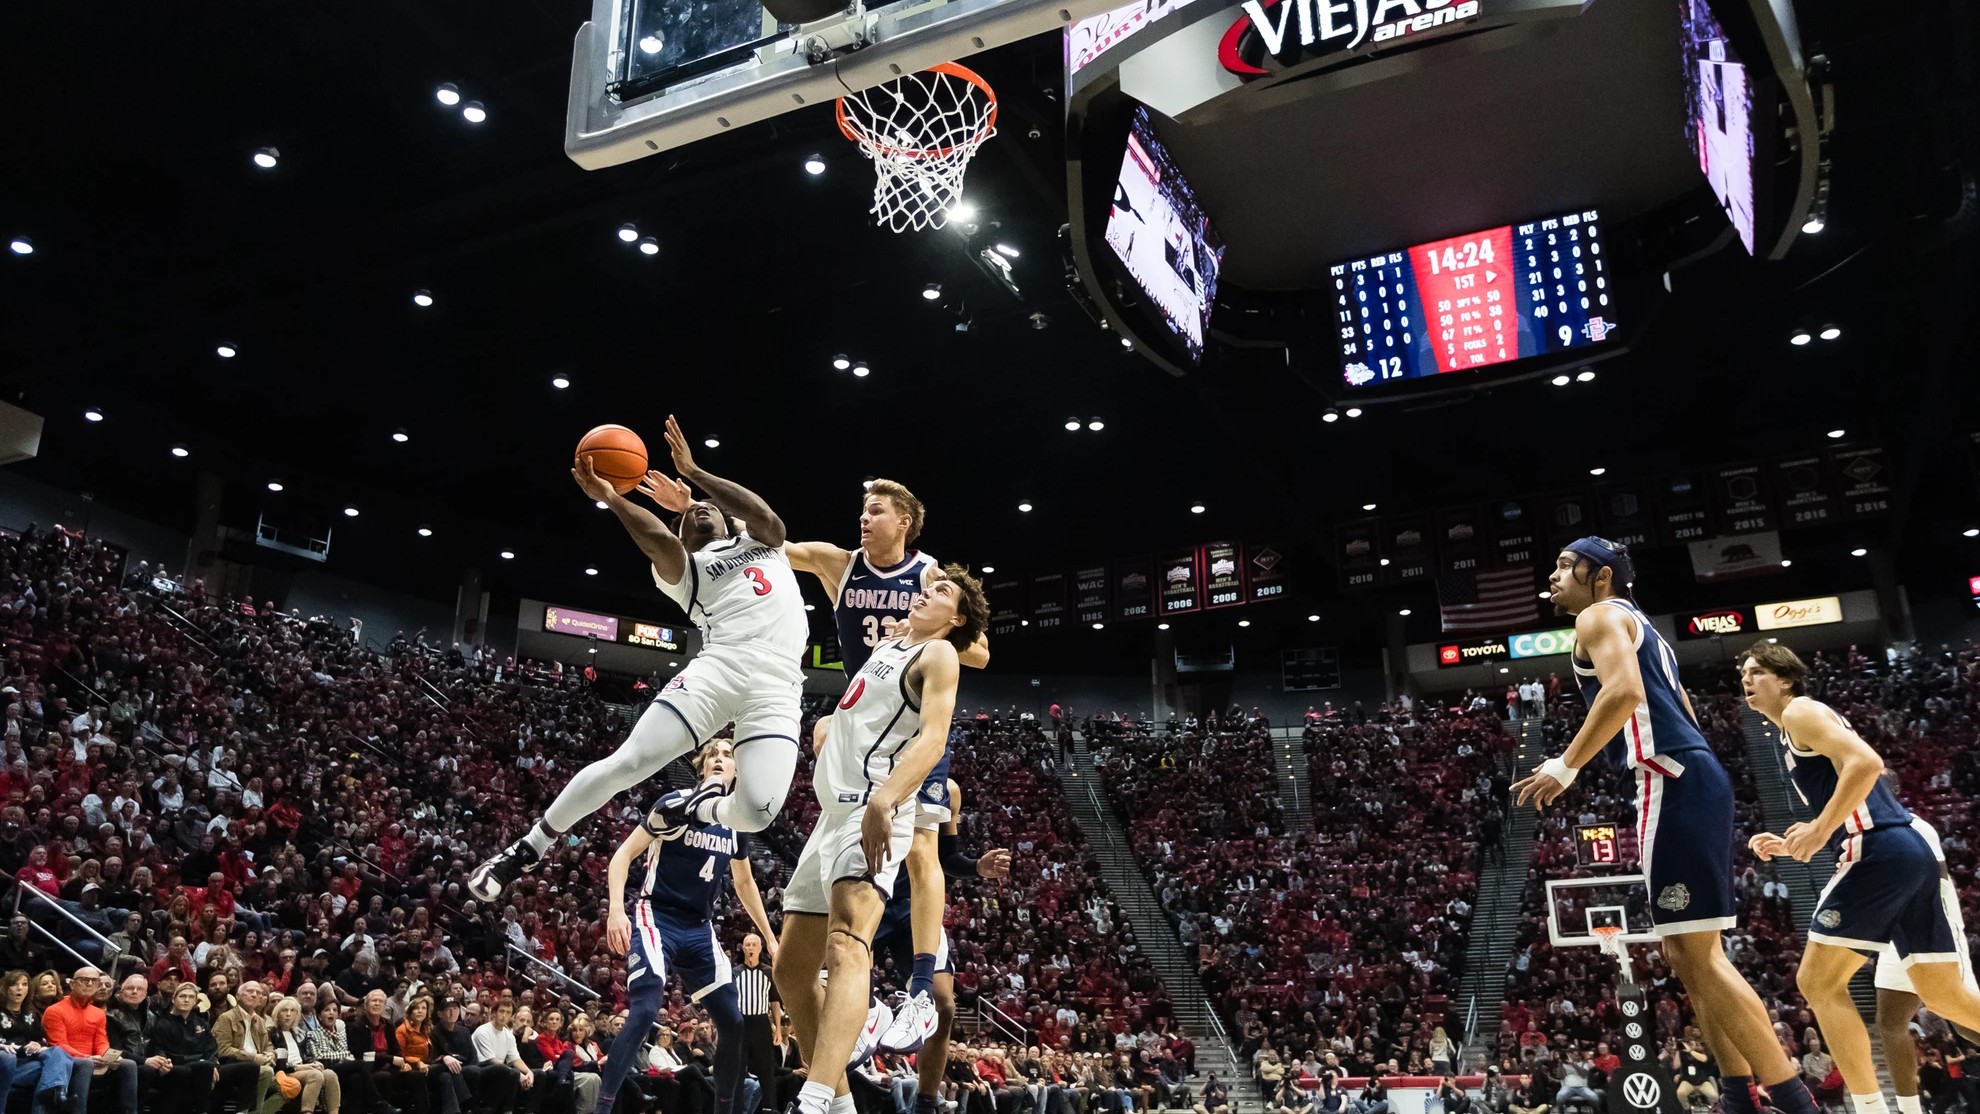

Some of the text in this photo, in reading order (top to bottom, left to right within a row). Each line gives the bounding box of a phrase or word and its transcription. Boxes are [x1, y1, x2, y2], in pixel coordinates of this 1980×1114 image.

[1373, 0, 1478, 42] arena
[1079, 11, 1142, 69] OURT
[1519, 211, 1598, 235] PLY PTS REB FLS
[1526, 226, 1596, 250] 2 3 2 0
[1331, 253, 1402, 276] PLY PTS REB FLS
[1428, 239, 1495, 275] 14:24
[1529, 243, 1599, 266] 3 3 0 0
[1336, 268, 1400, 289] 0 3 1 1
[1454, 275, 1475, 290] 1ST
[1529, 260, 1601, 284] 21 0 3 1
[1340, 284, 1403, 305] 4 0 0 0
[1532, 277, 1604, 301] 31 3 0 0
[1340, 300, 1406, 322] 11 0 1 0
[1438, 290, 1500, 313] 50 3PT % 50
[1534, 294, 1607, 317] 40 0 0 0
[1440, 305, 1502, 327] 50 FG % 38
[1342, 317, 1408, 338] 33 0 0 0
[1442, 320, 1502, 341] 67 FT % 0
[1559, 326, 1572, 346] 9
[1344, 333, 1410, 354] 34 5 0 0
[1447, 334, 1504, 354] 5 FOULS 2
[1380, 357, 1402, 378] 12
[1449, 348, 1506, 368] 4 TOL 4
[1675, 527, 1703, 538] 2014
[1734, 518, 1764, 530] 2015
[1499, 537, 1522, 547] SWEET
[706, 560, 726, 581] SAN
[728, 552, 754, 570] DIEGO
[1453, 559, 1476, 569] 2011
[1506, 551, 1530, 562] 2011
[743, 567, 772, 596] 3
[1349, 573, 1373, 585] 2010
[1402, 567, 1423, 577] 2011
[1078, 579, 1104, 591] WAC
[1257, 585, 1282, 597] 2009
[845, 588, 919, 611] GONZAGA
[1168, 599, 1192, 610] 2006
[1213, 592, 1237, 604] 2006
[1124, 606, 1147, 616] 2002
[996, 625, 1015, 635] 1977
[1039, 618, 1060, 628] 1978
[1693, 615, 1737, 632] VIEJAS
[641, 637, 654, 646] San
[655, 640, 677, 650] Diego
[1462, 644, 1505, 657] TOYOTA
[1514, 630, 1577, 656] COX
[839, 677, 865, 710] 0
[684, 830, 732, 855] GONZAGA
[1582, 827, 1615, 841] 14:24
[1592, 840, 1614, 862] 13
[699, 855, 716, 882] 4
[1622, 1001, 1639, 1017] VW
[1626, 1023, 1642, 1038] VW
[1629, 1044, 1646, 1060] VW
[1623, 1072, 1660, 1108] VW
